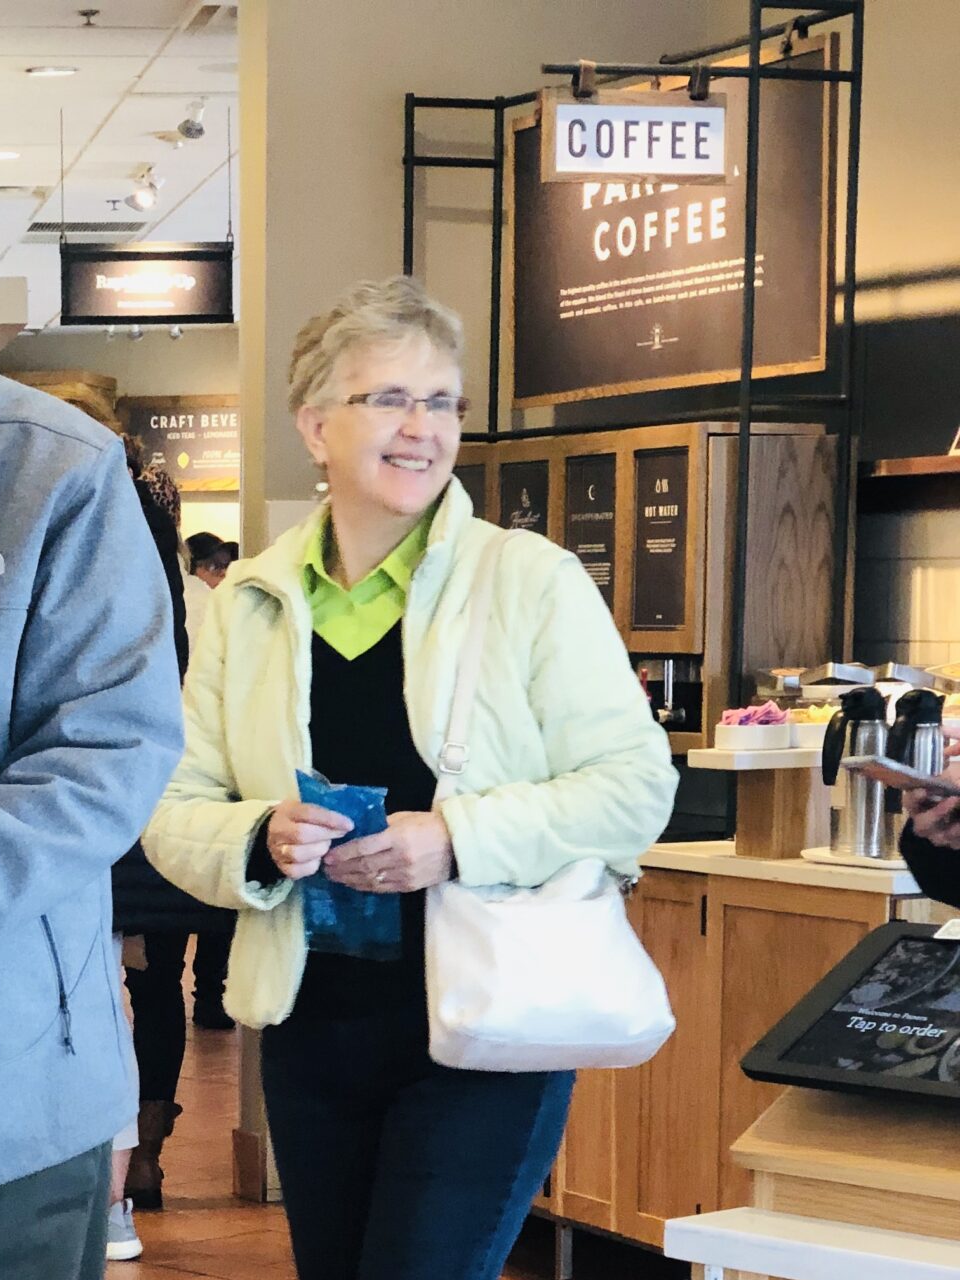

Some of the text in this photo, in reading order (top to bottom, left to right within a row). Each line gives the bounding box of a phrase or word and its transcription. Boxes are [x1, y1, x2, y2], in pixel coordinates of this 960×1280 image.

[568, 118, 711, 160] COFFEE
[594, 196, 727, 262] COFFEE
[150, 412, 238, 429] CRAFT BEVE
[644, 505, 657, 518] HOT
[846, 1016, 947, 1038] Tap to order
